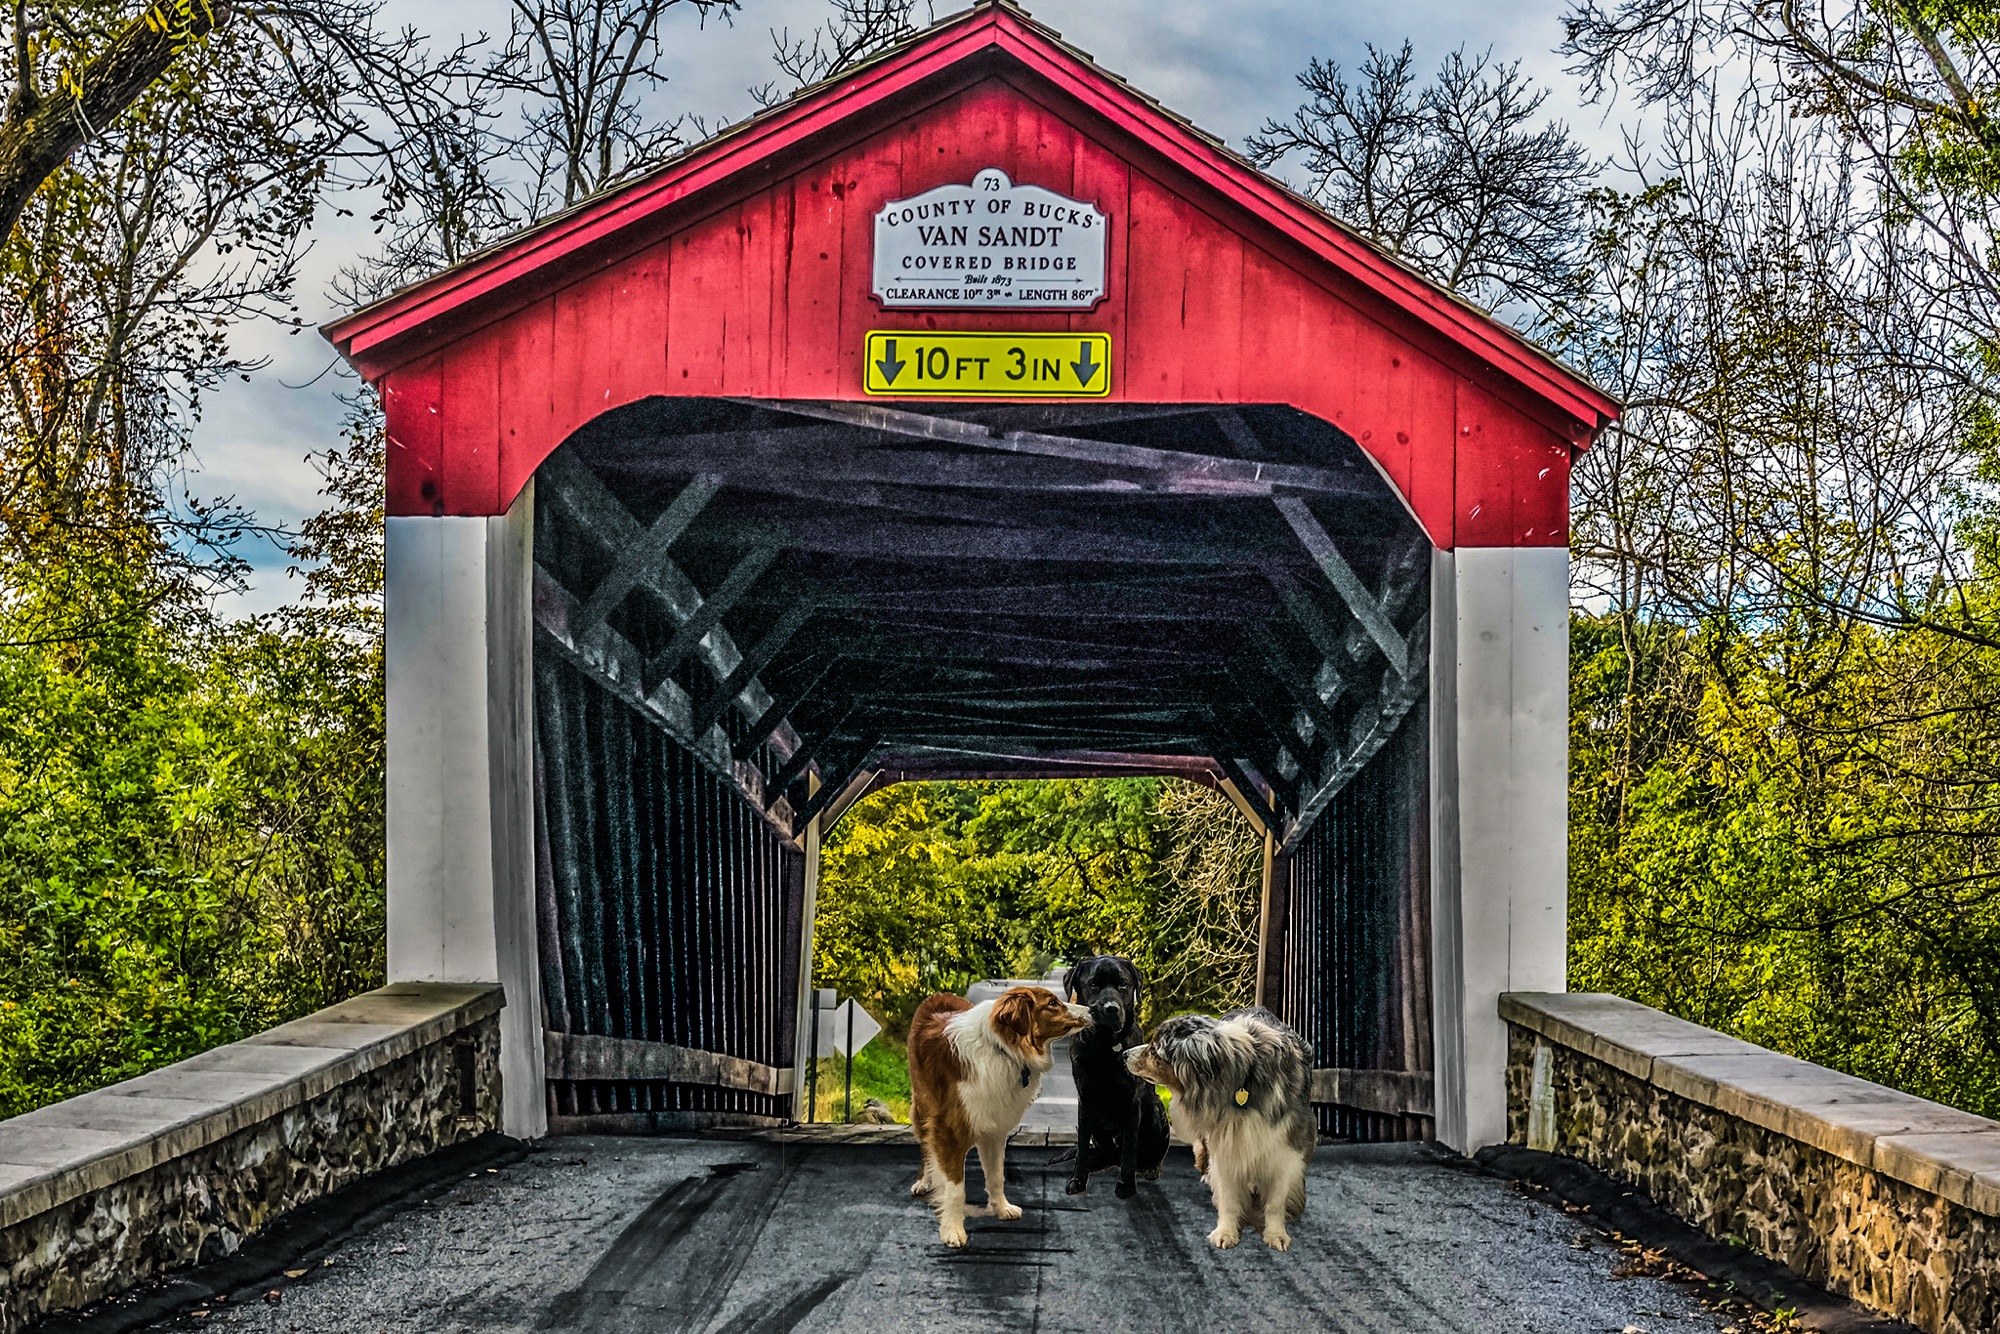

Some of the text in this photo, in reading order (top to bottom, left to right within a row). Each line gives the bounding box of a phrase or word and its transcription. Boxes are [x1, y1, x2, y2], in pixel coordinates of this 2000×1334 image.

[984, 178, 1000, 191] 73
[887, 200, 1093, 229] COUNTY OF BUCKS
[918, 226, 1063, 247] VAN SANDT
[902, 256, 1077, 270] COVERED BRIDGE
[964, 275, 1012, 286] Built 1873
[886, 288, 960, 300] CLEARANCE
[1019, 290, 1067, 300] LENGTH
